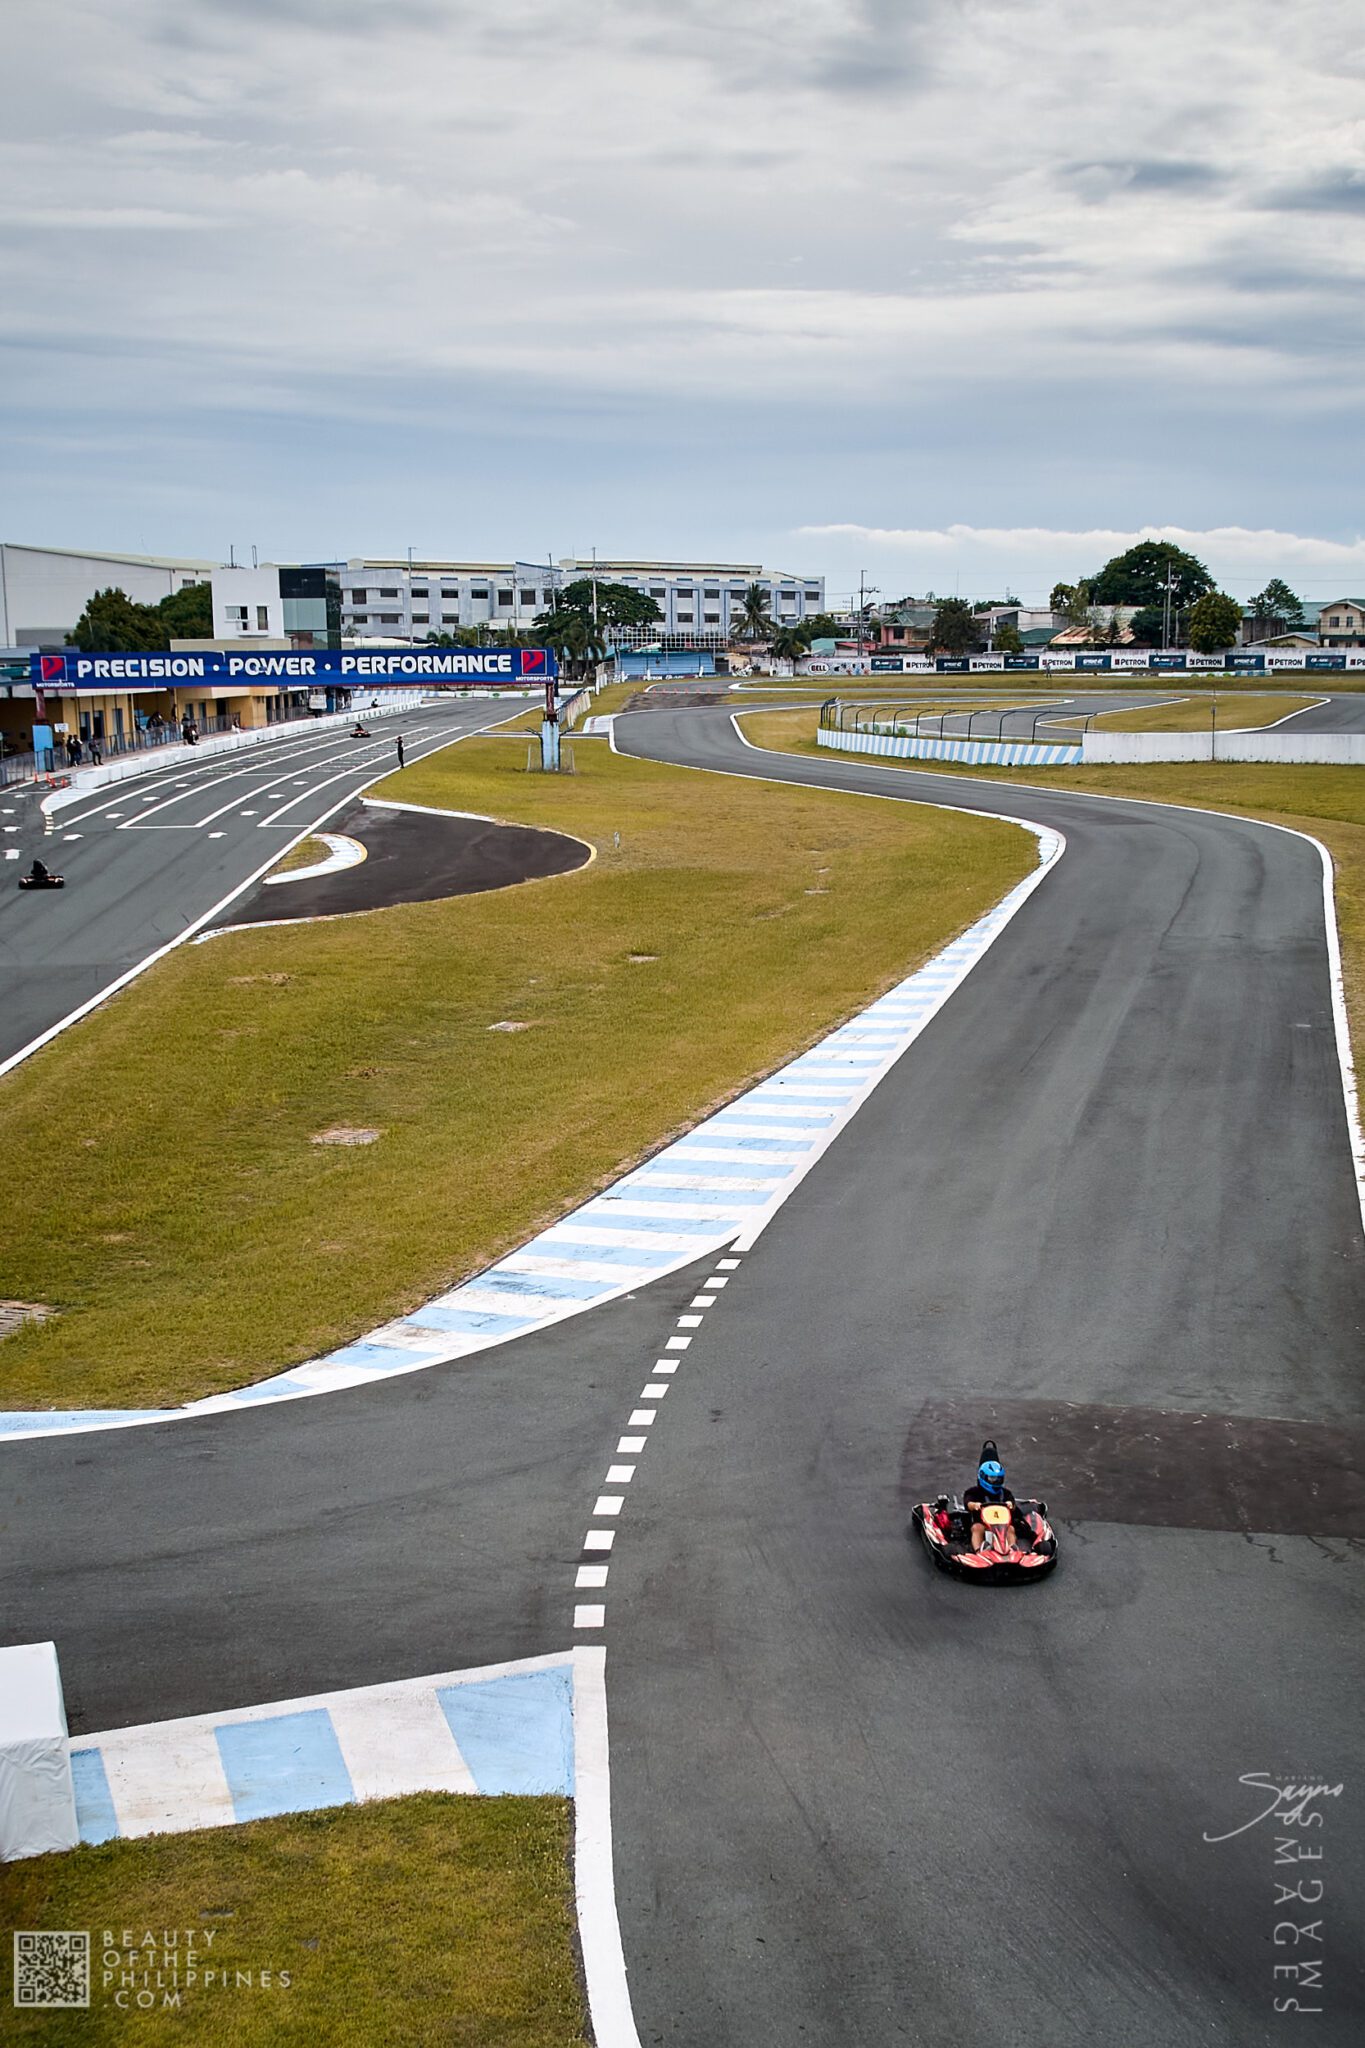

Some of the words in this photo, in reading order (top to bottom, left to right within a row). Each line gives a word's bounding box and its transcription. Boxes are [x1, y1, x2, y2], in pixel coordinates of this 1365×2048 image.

[77, 658, 205, 678] PRECISION
[229, 656, 316, 676] POWER
[341, 654, 512, 674] PERFORMANCE
[1196, 658, 1222, 666] PETRON
[1275, 658, 1302, 666] PETRON
